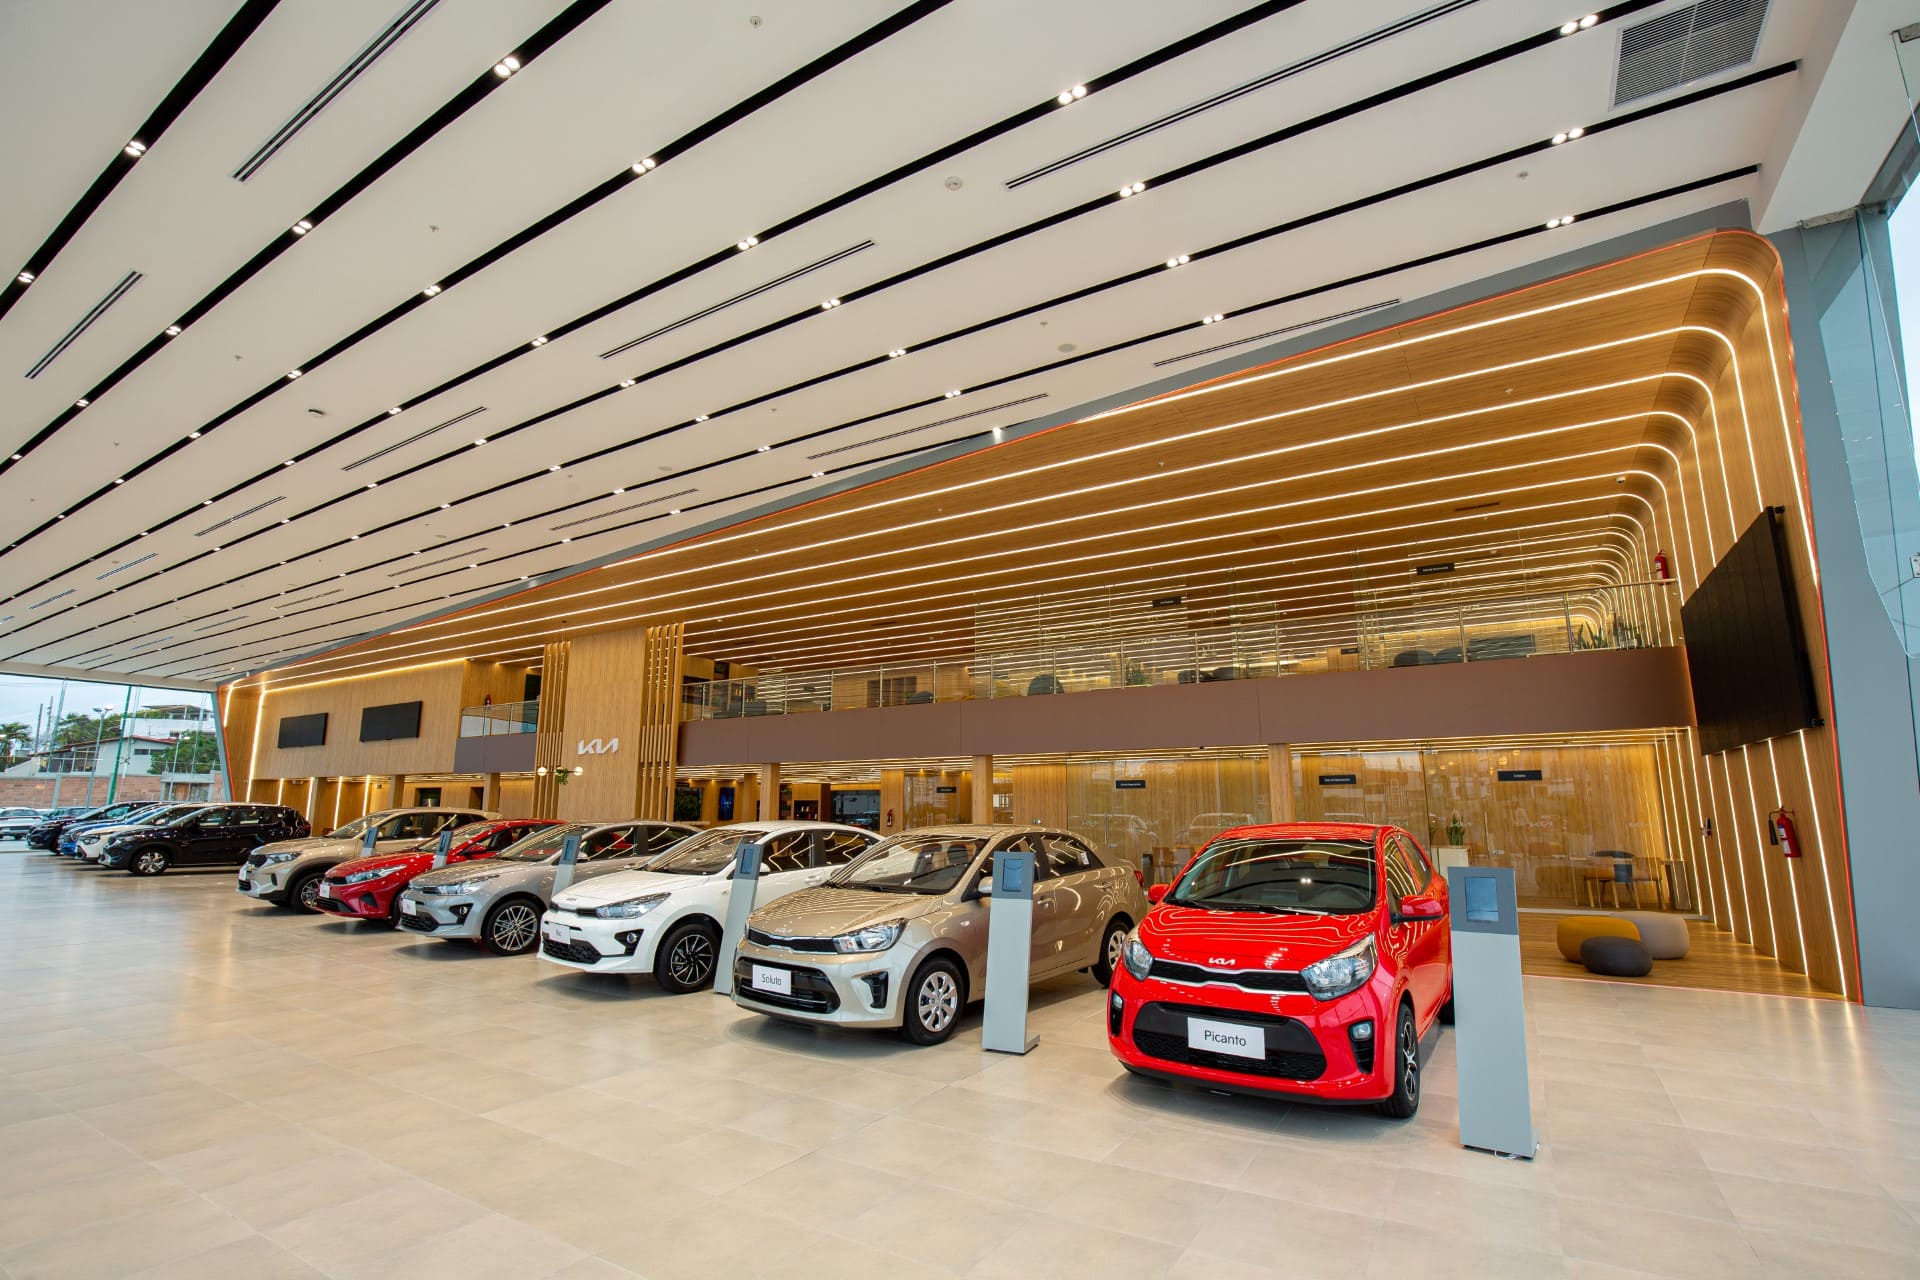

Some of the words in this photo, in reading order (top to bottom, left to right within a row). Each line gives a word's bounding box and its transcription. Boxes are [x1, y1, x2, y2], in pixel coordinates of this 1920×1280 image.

[577, 737, 619, 756] KIA
[1208, 956, 1236, 966] KIA
[761, 973, 782, 986] Soluto
[1204, 1029, 1247, 1047] Picanto
